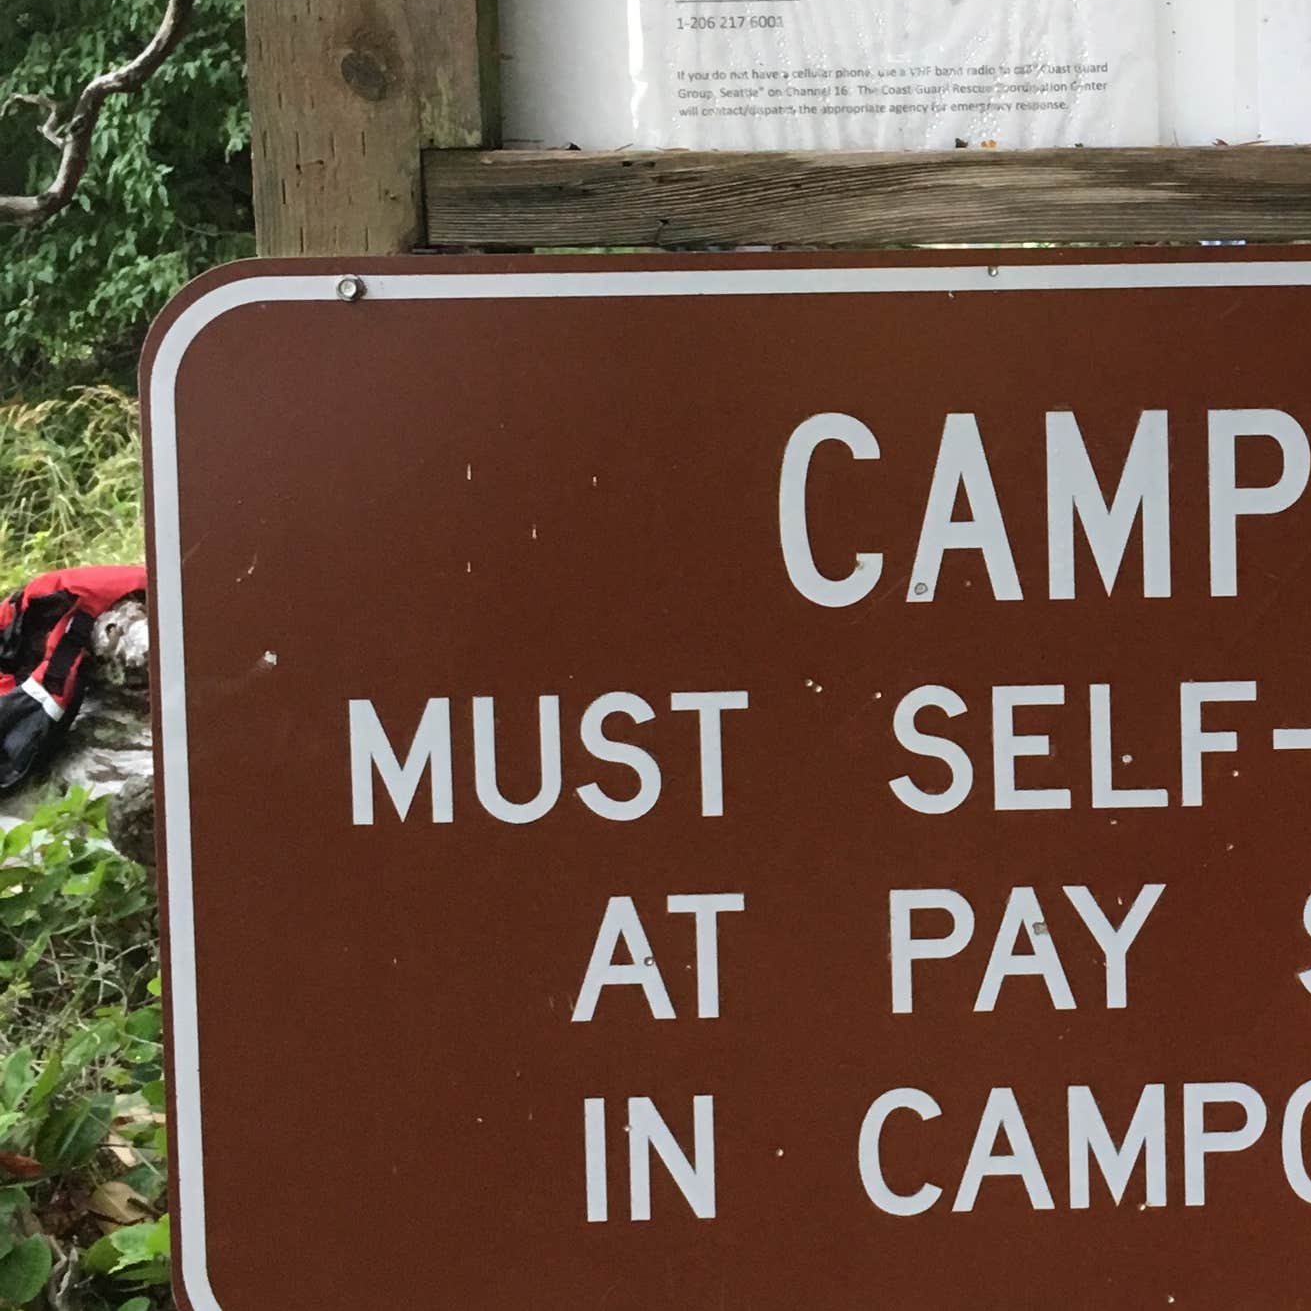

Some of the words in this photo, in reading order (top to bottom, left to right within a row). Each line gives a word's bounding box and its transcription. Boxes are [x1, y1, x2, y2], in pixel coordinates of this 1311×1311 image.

[676, 16, 716, 30] 1-206
[720, 16, 746, 29] 217
[345, 689, 750, 829] MUST
[570, 892, 746, 1023] AT
[887, 882, 1168, 1018] PAY
[582, 1092, 718, 1223] IN
